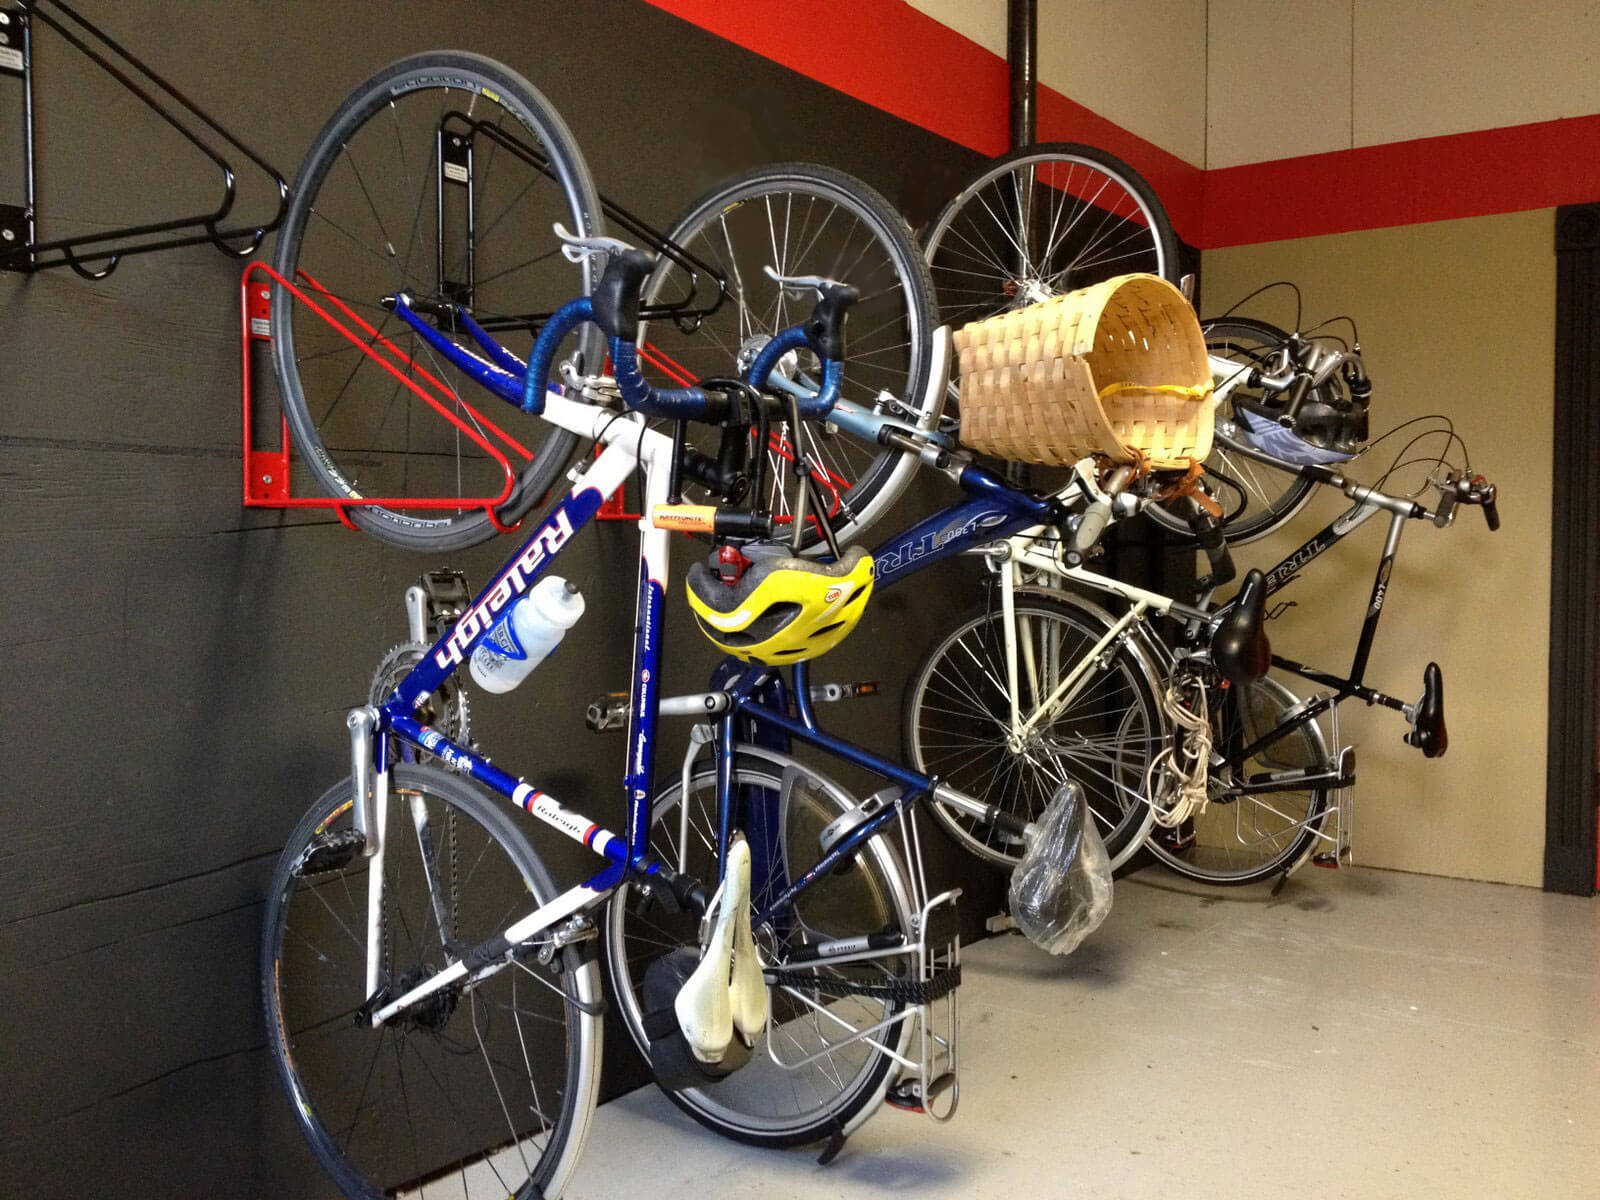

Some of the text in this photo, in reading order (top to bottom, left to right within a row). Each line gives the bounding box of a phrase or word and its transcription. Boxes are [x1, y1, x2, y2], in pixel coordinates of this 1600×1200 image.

[946, 522, 977, 543] L380
[875, 531, 943, 579] TR
[435, 509, 575, 670] Raleigh
[1374, 584, 1386, 609] L400
[537, 806, 581, 833] Raleigh
